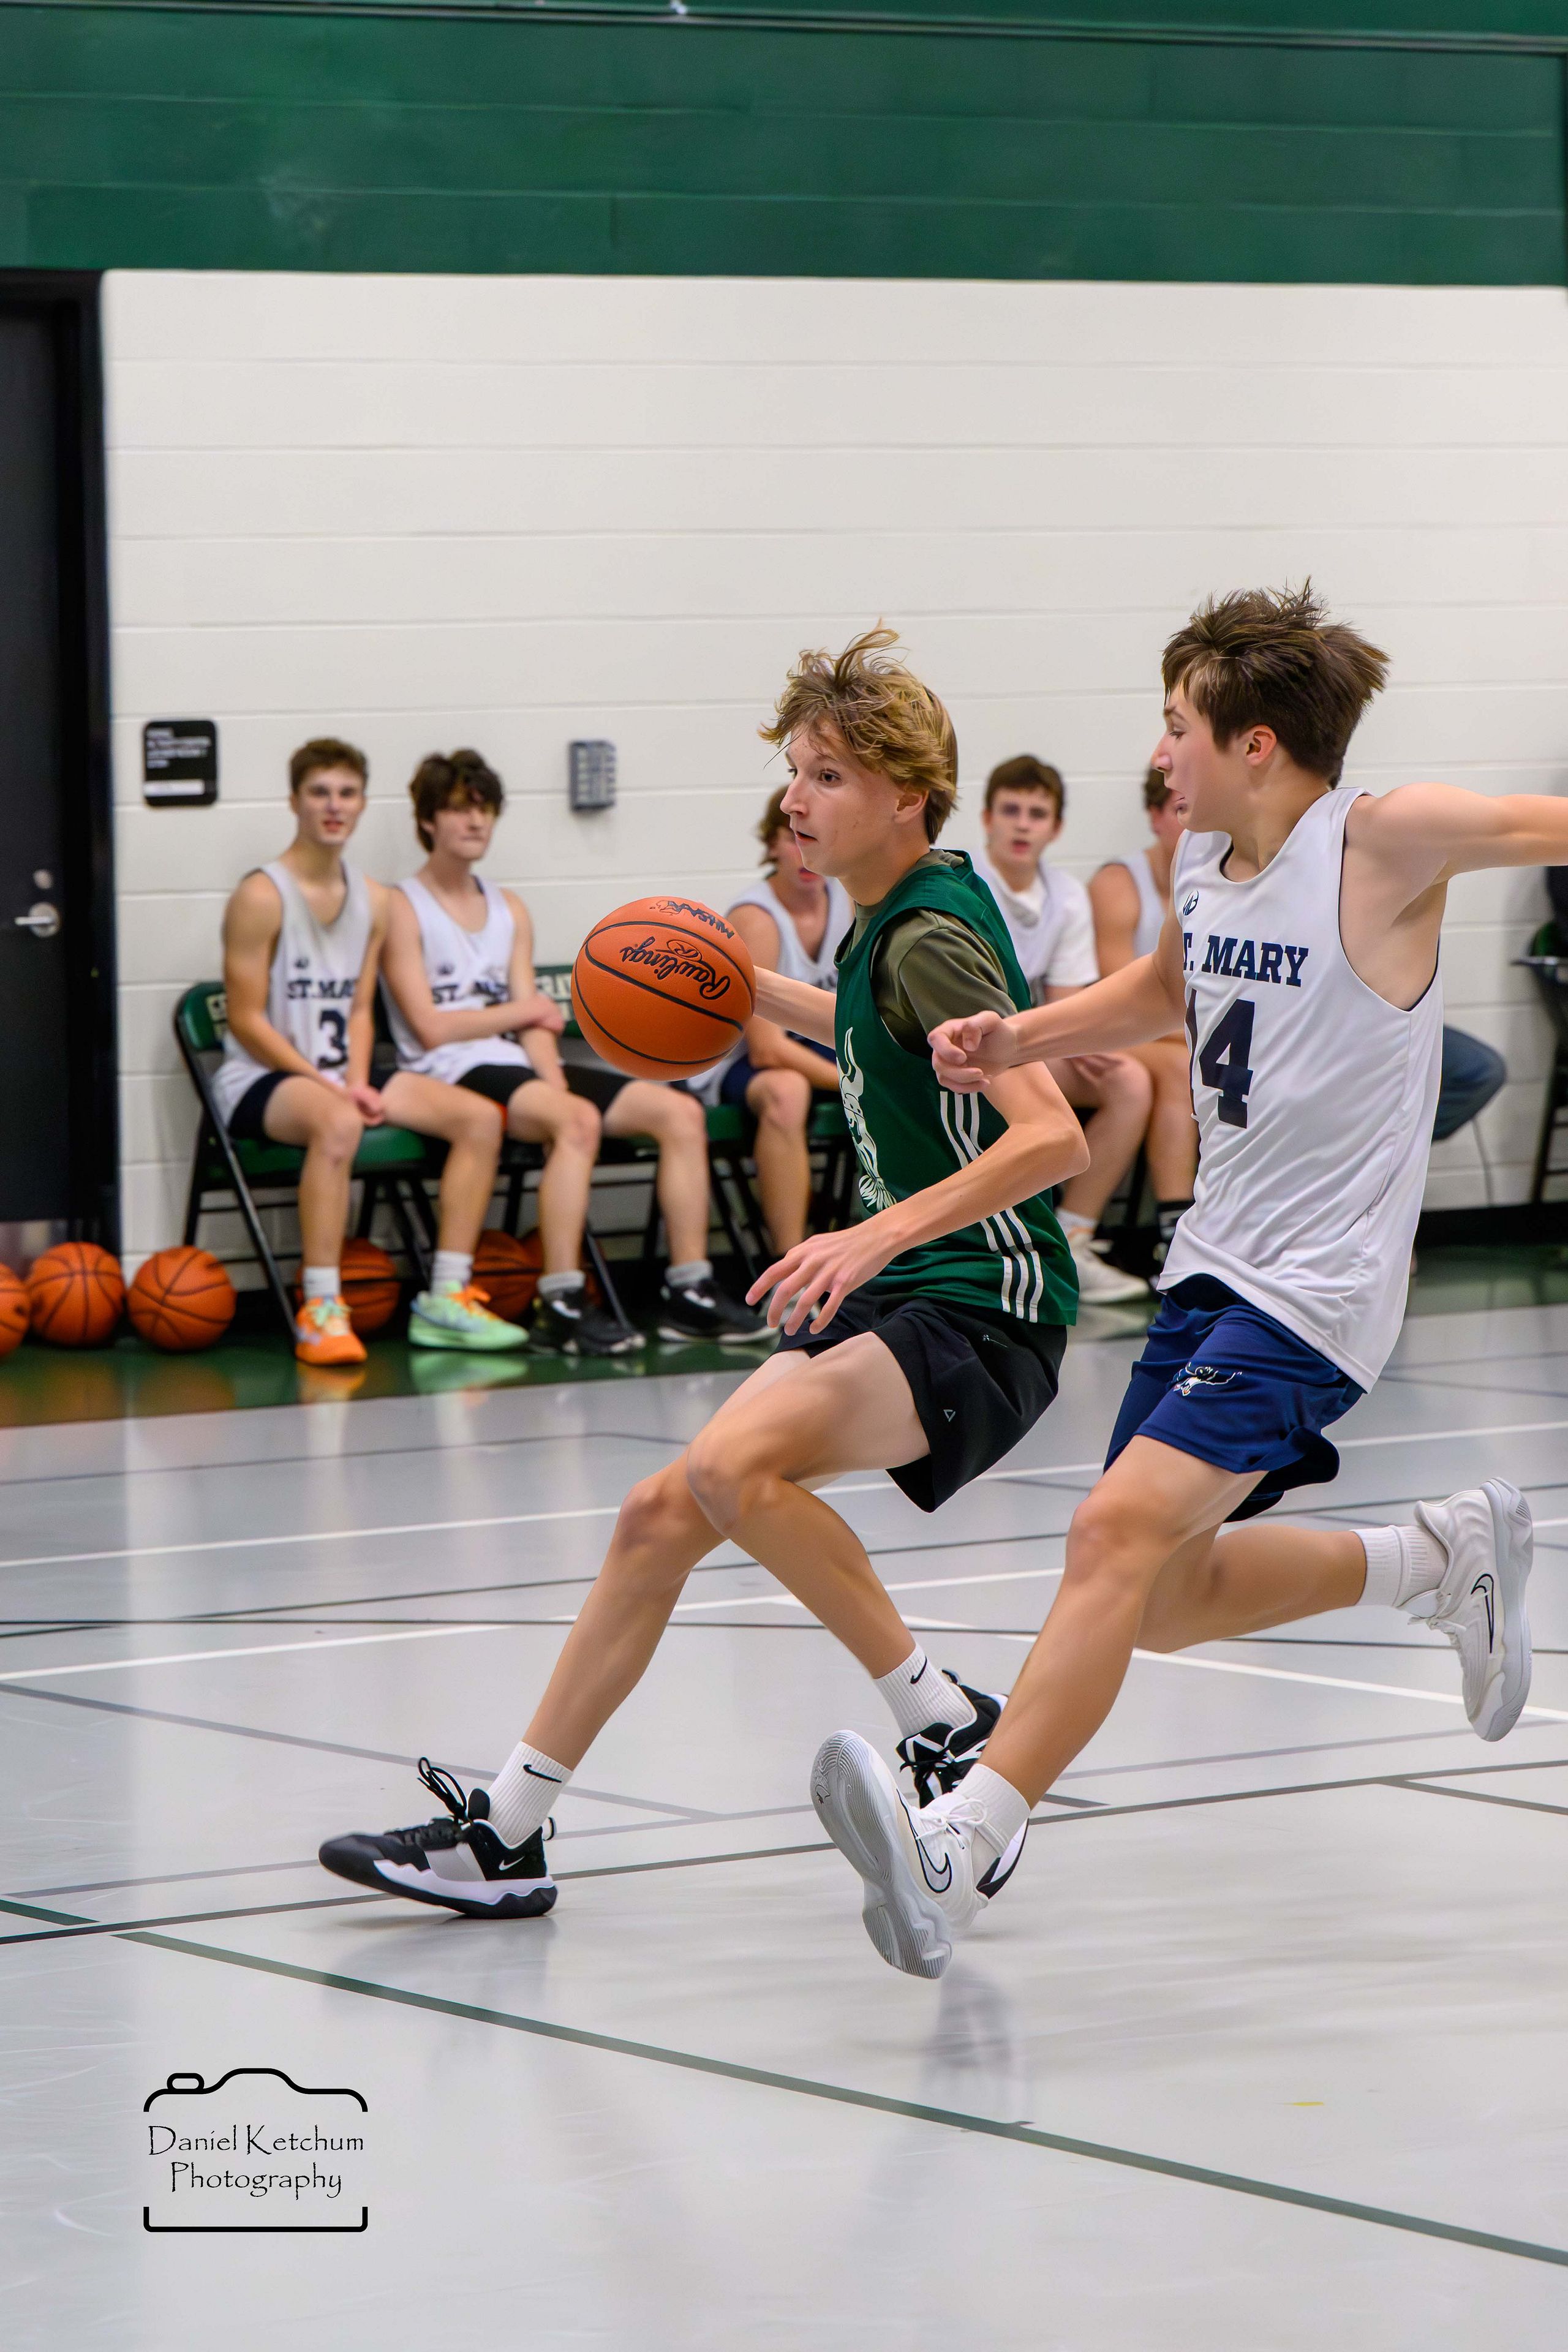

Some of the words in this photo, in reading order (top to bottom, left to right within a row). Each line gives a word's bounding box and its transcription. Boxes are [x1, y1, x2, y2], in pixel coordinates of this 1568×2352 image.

[619, 935, 731, 1000] Rawlings
[1183, 932, 1194, 971] T.
[1201, 935, 1310, 988] MARY
[317, 1009, 349, 1069] 3
